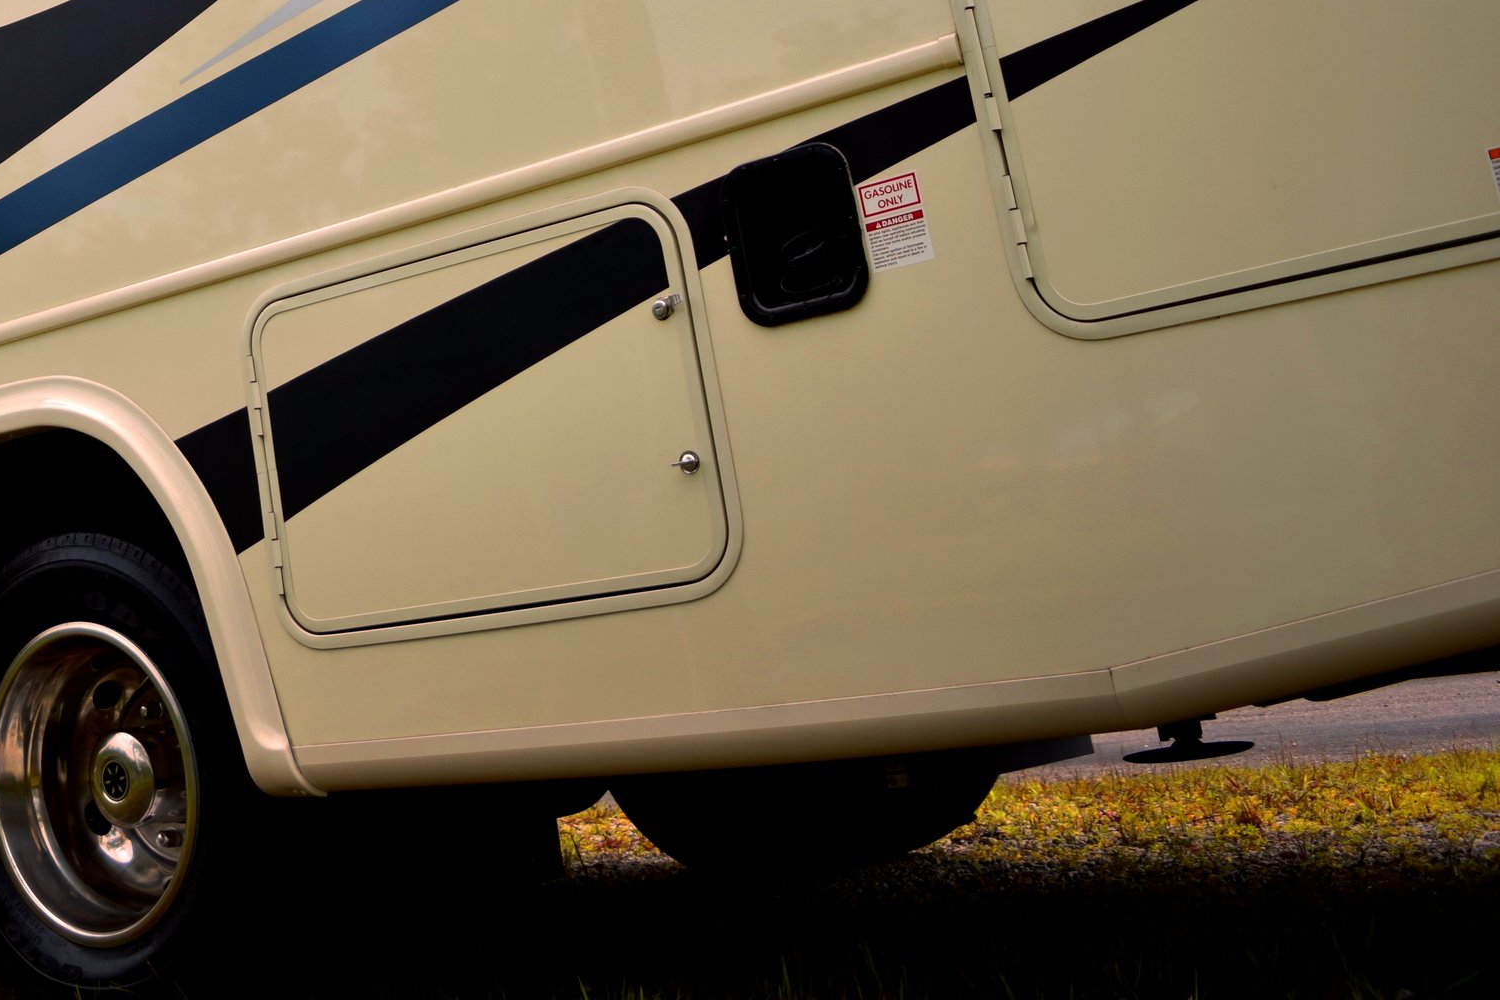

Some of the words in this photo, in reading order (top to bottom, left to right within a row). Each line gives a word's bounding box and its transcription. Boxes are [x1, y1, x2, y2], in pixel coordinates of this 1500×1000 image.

[864, 179, 913, 200] GASOLINE
[877, 194, 903, 209] ONLY
[881, 213, 914, 227] DANGER
